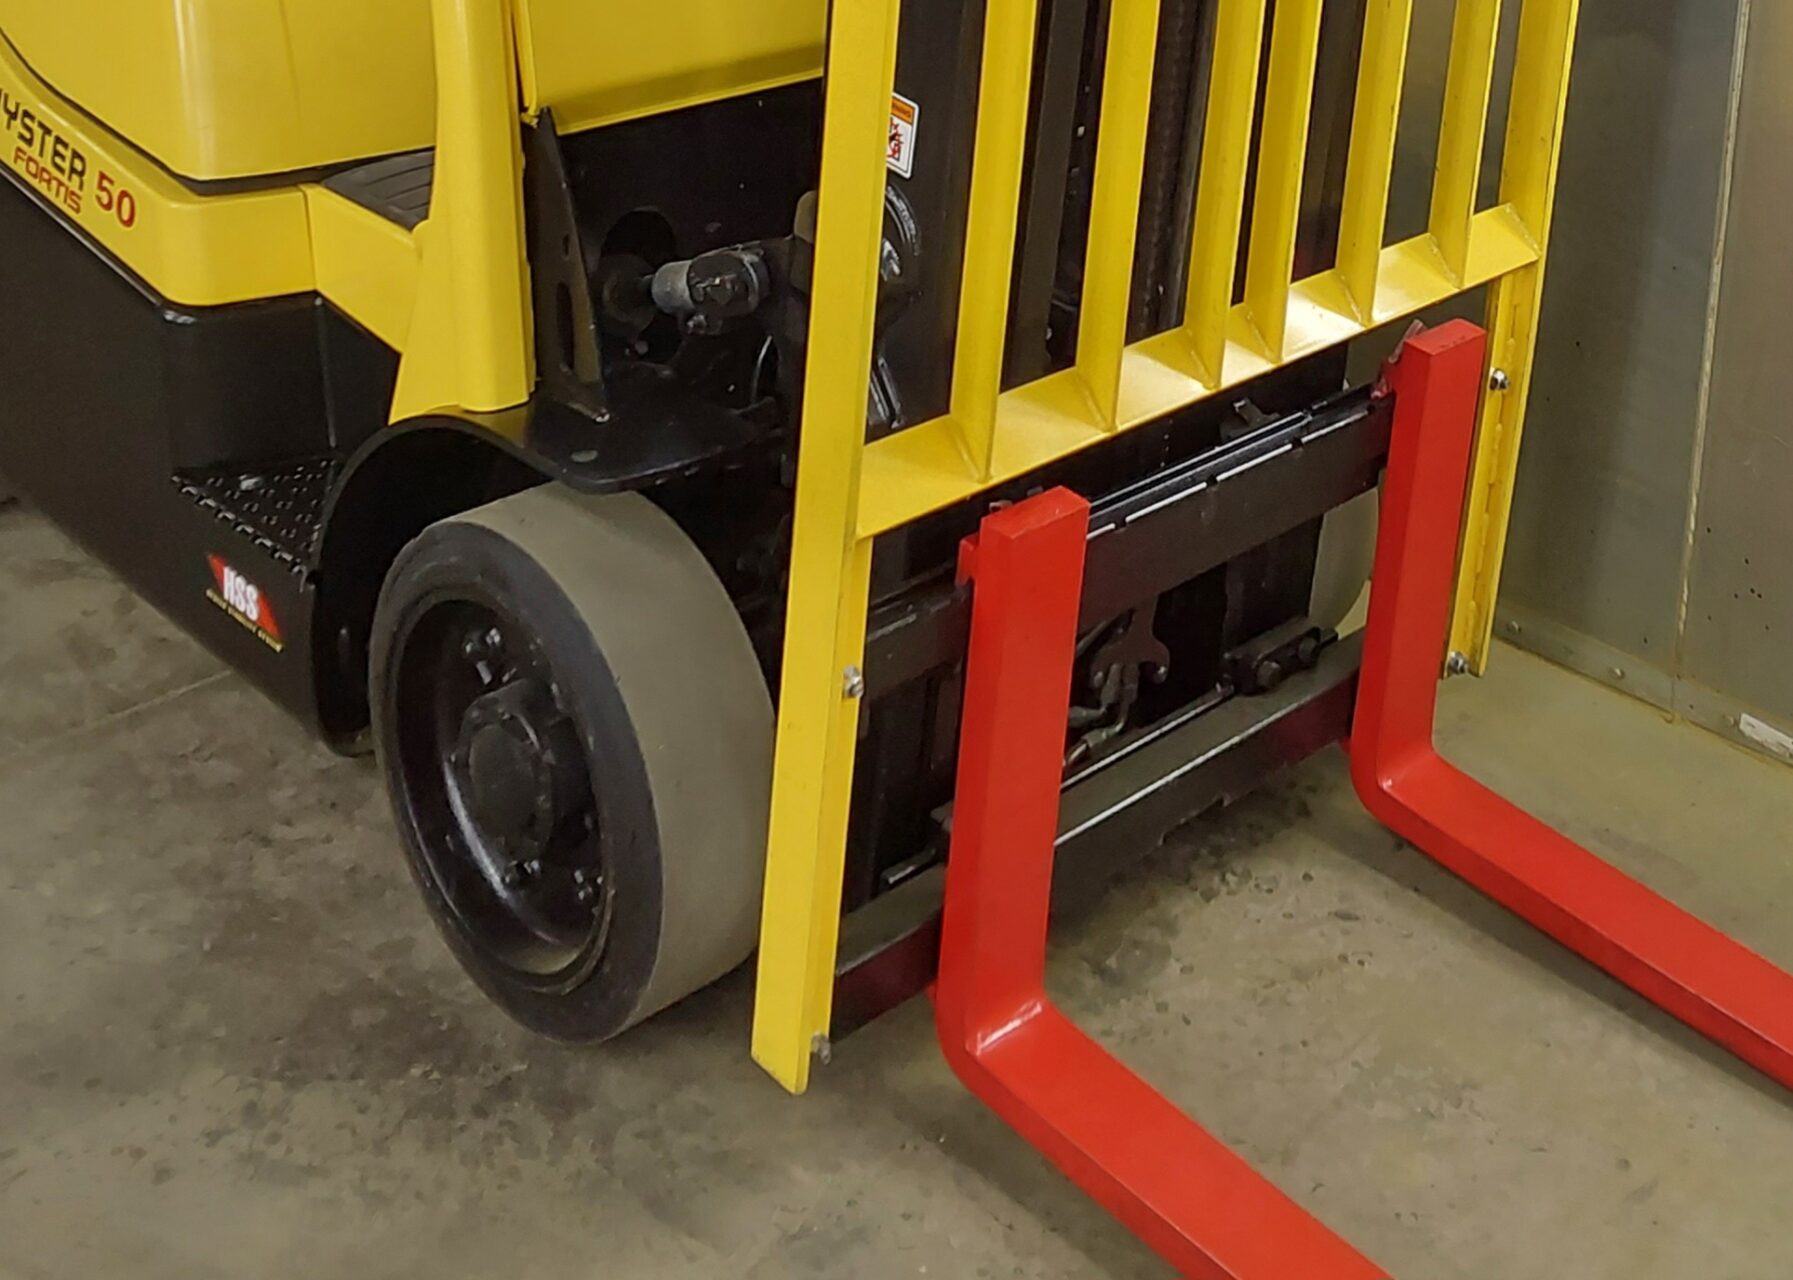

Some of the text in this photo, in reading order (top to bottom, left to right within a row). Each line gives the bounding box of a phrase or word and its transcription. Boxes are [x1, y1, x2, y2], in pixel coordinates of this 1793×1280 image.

[0, 88, 87, 192] YSTER
[13, 146, 82, 215] FORTIS
[94, 170, 136, 228] 50
